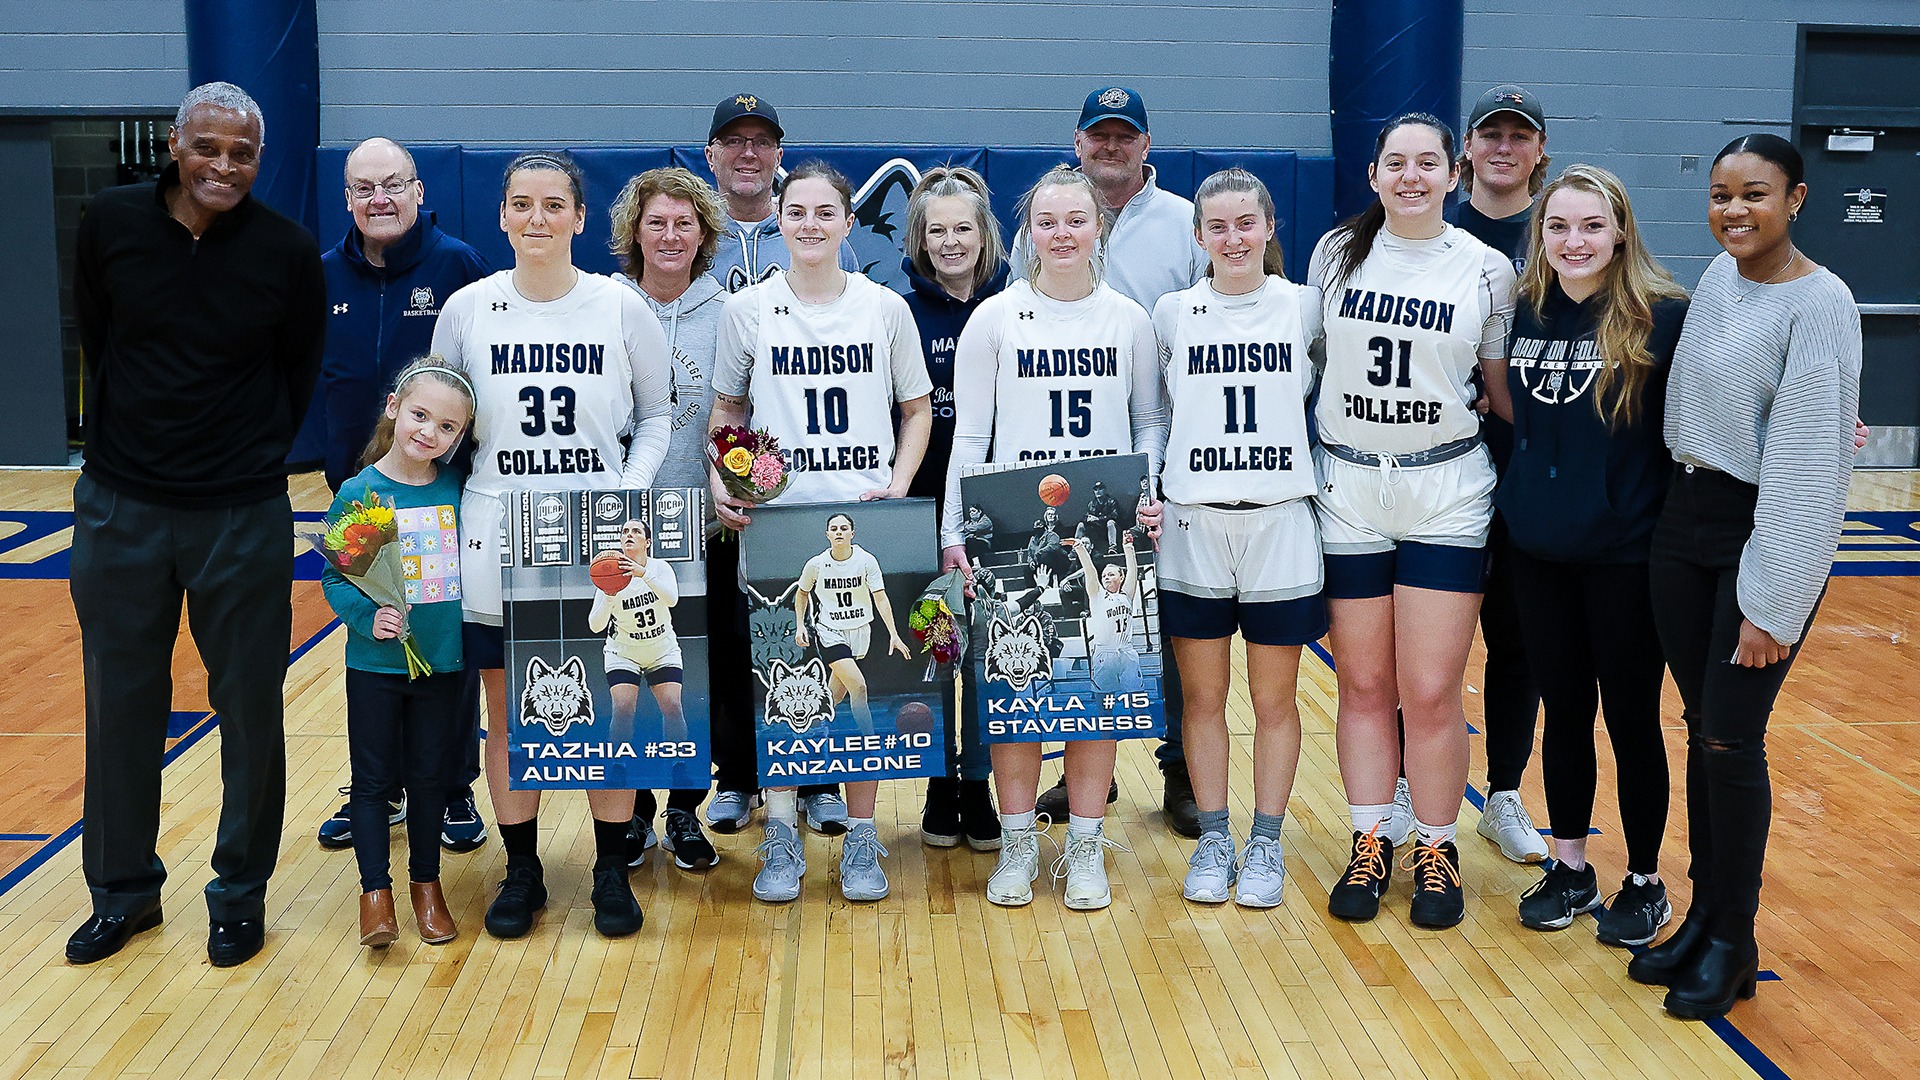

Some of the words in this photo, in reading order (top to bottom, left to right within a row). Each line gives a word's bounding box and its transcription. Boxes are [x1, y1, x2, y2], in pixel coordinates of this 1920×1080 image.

[1338, 288, 1455, 334] MADISON
[490, 343, 605, 376] MADISON
[771, 342, 874, 376] MADISON
[1017, 346, 1117, 378] MADISON
[1187, 342, 1292, 376] MADISON
[1367, 336, 1413, 388] 31
[518, 386, 577, 436] 33
[803, 387, 849, 435] 10
[1048, 389, 1092, 437] 15
[1223, 385, 1258, 434] 11
[497, 448, 605, 475] COLLEGE
[780, 445, 879, 472] COLLEGE
[1189, 445, 1293, 472] COLLEGE
[522, 514, 531, 558] MADISON
[824, 576, 862, 589] MADISON
[836, 591, 852, 607] 10
[634, 608, 656, 628] 33
[829, 608, 865, 620] COLLEGE
[630, 624, 665, 640] COLLEGE
[987, 697, 1085, 714] KAYLA
[1102, 692, 1150, 710] #15
[988, 715, 1153, 735] STAVENESS
[521, 743, 637, 759] TAZHIA
[644, 741, 696, 758] #33
[767, 735, 881, 756] KAYLEE
[884, 732, 931, 750] #10
[521, 765, 605, 782] AUNE
[767, 755, 922, 777] ANZALONE
